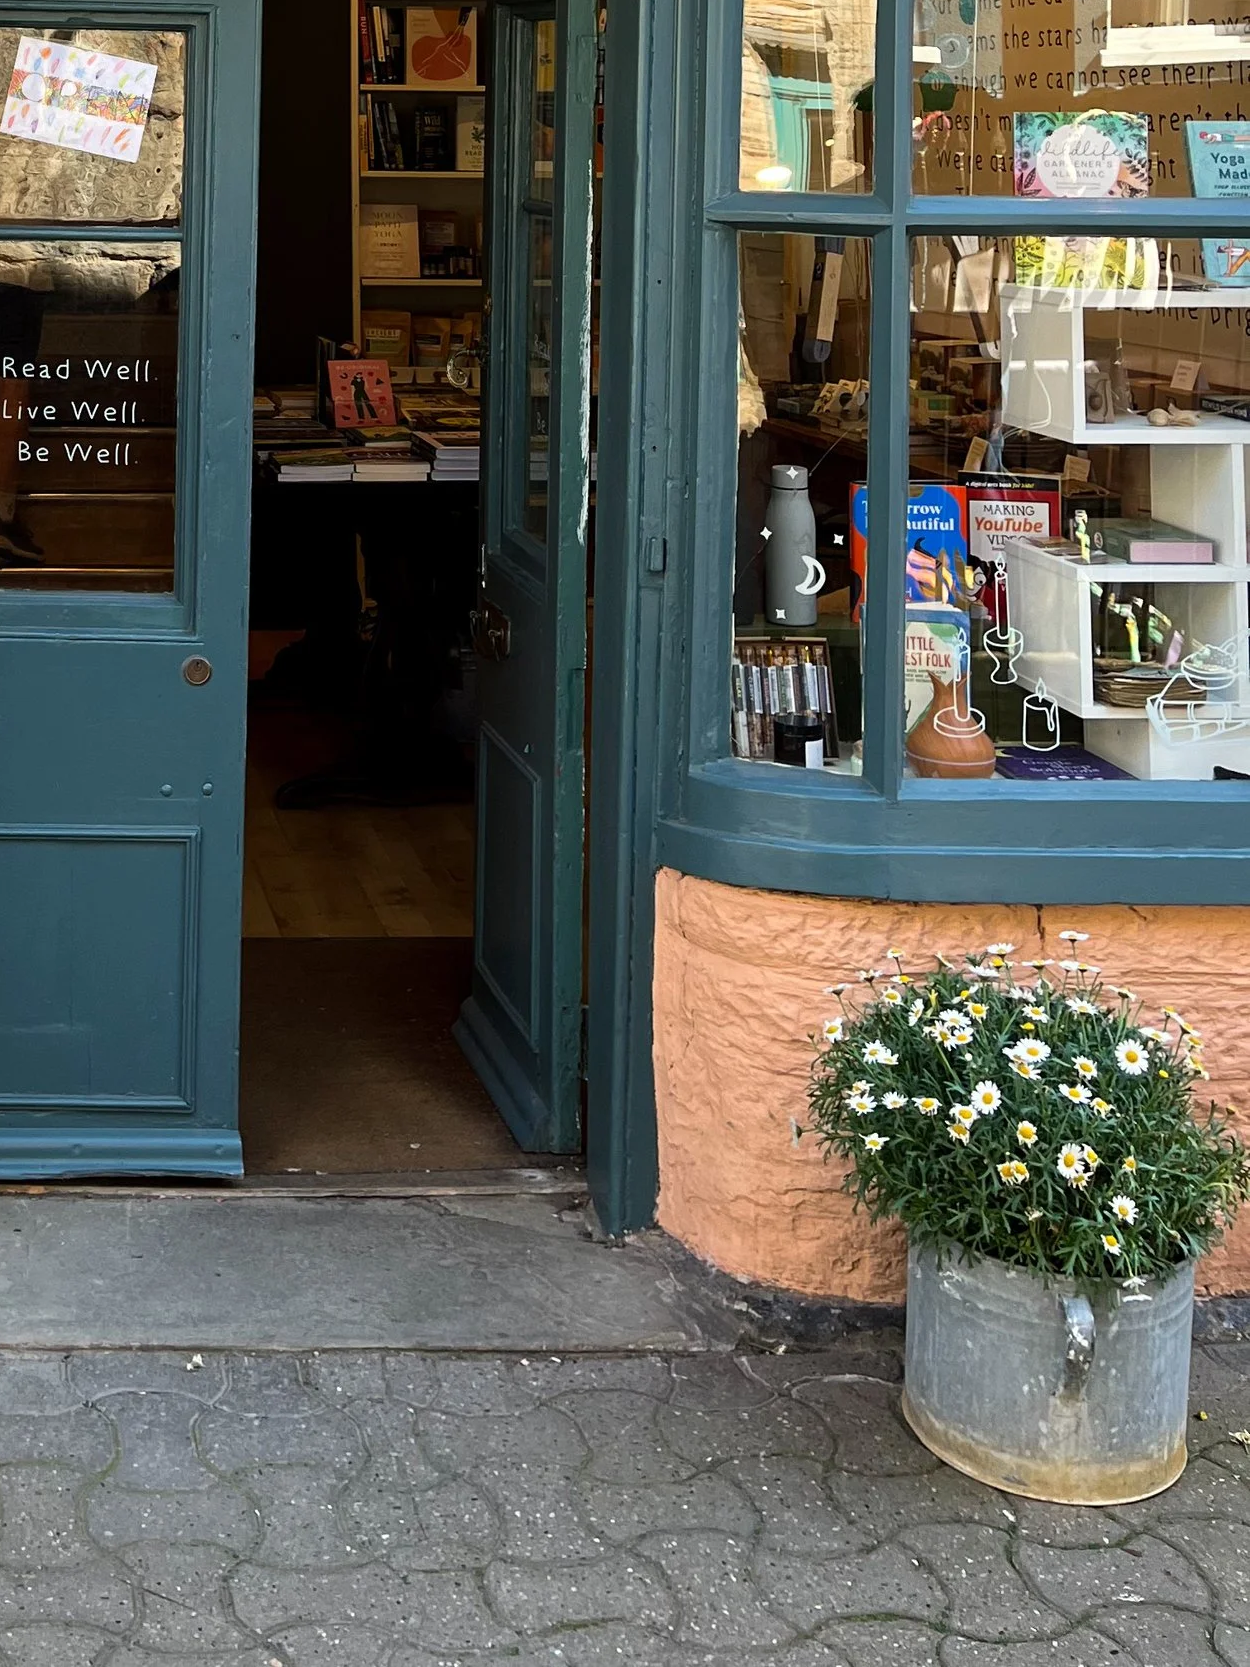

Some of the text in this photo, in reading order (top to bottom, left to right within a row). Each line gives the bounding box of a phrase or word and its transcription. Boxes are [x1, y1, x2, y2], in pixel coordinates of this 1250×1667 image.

[1003, 23, 1083, 50] the stars
[1013, 71, 1038, 90] we
[1045, 67, 1108, 88] cannot
[1118, 65, 1151, 87] see
[1161, 63, 1215, 89] their
[1210, 152, 1245, 167] Yoga
[1218, 168, 1250, 180] Mad
[2, 356, 159, 383] Read Well.
[2, 398, 146, 424] Live Well.
[18, 440, 139, 466] Be Well.
[983, 504, 1035, 516] MAKING
[974, 516, 1043, 533] YouTube
[926, 652, 952, 667] FOLK
